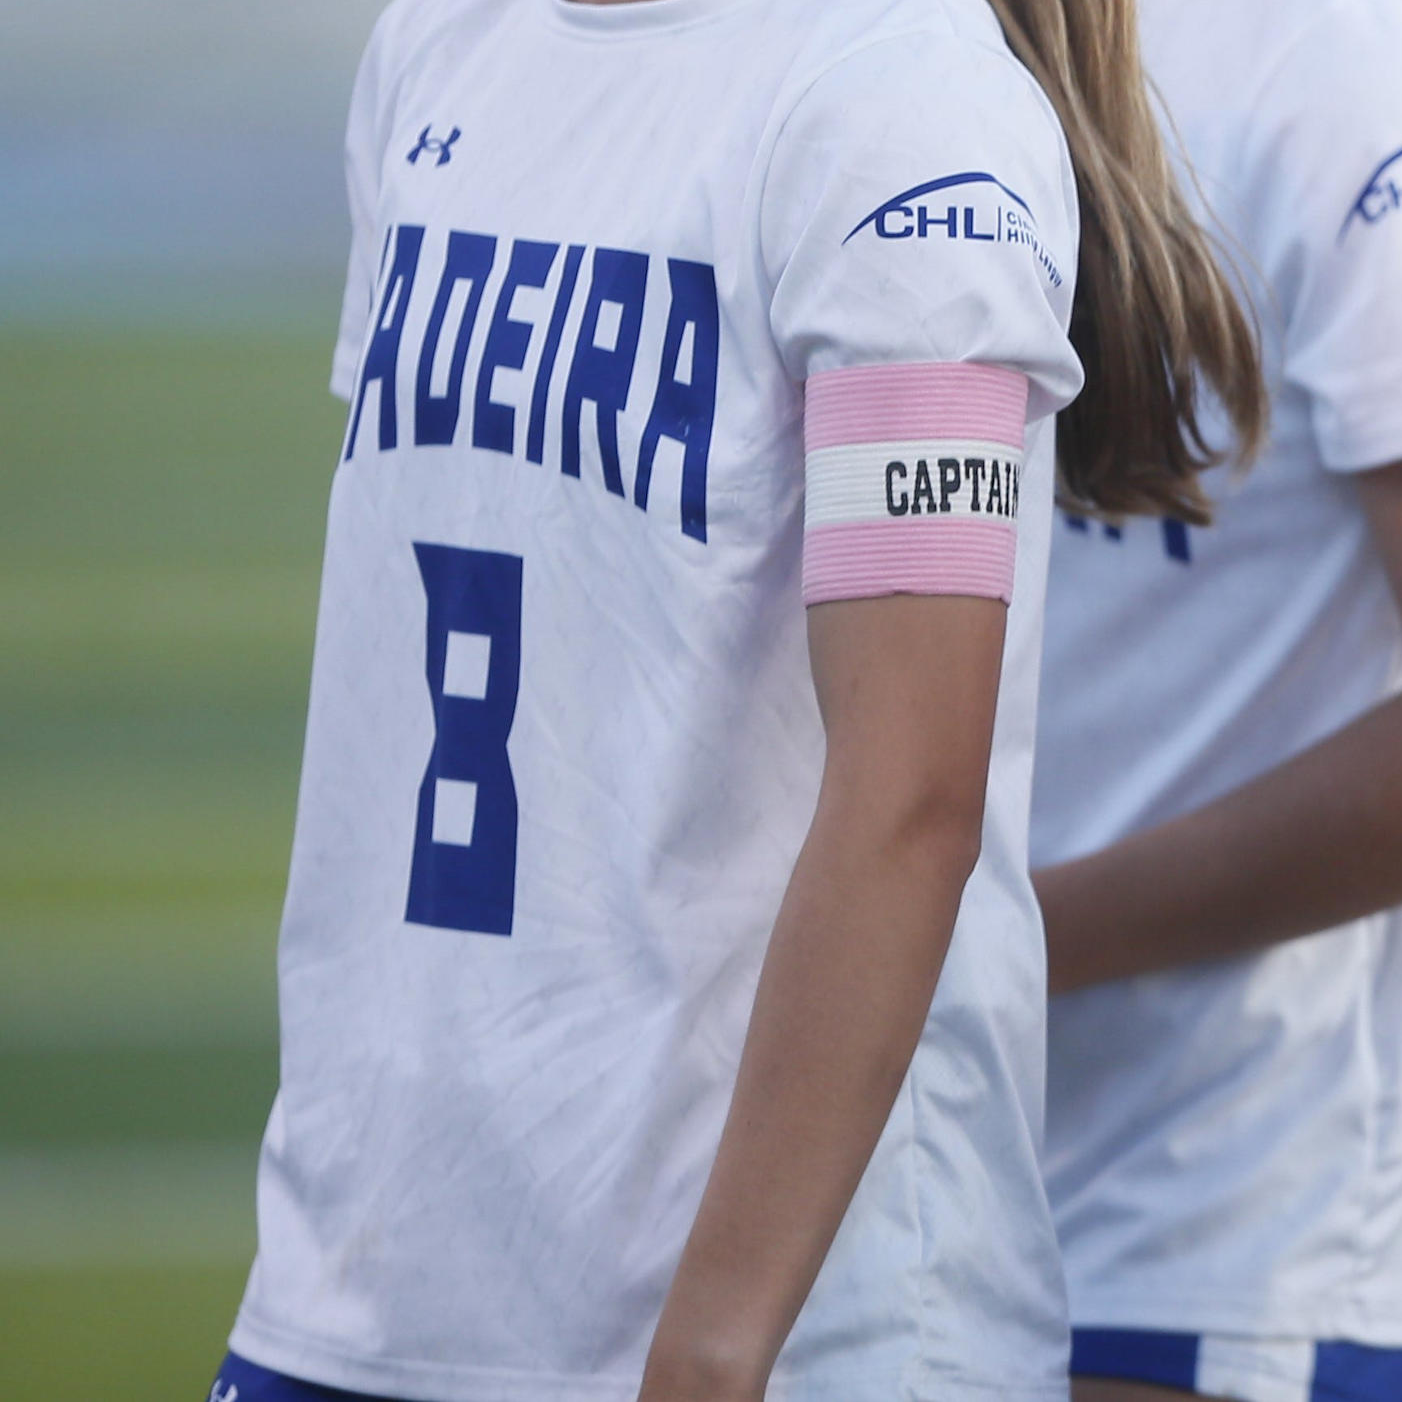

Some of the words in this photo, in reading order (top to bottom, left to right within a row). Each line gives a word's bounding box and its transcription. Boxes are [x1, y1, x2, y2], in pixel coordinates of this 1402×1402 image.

[874, 204, 995, 241] CHL
[343, 223, 720, 545] ADEIRA
[403, 541, 524, 937] 8
